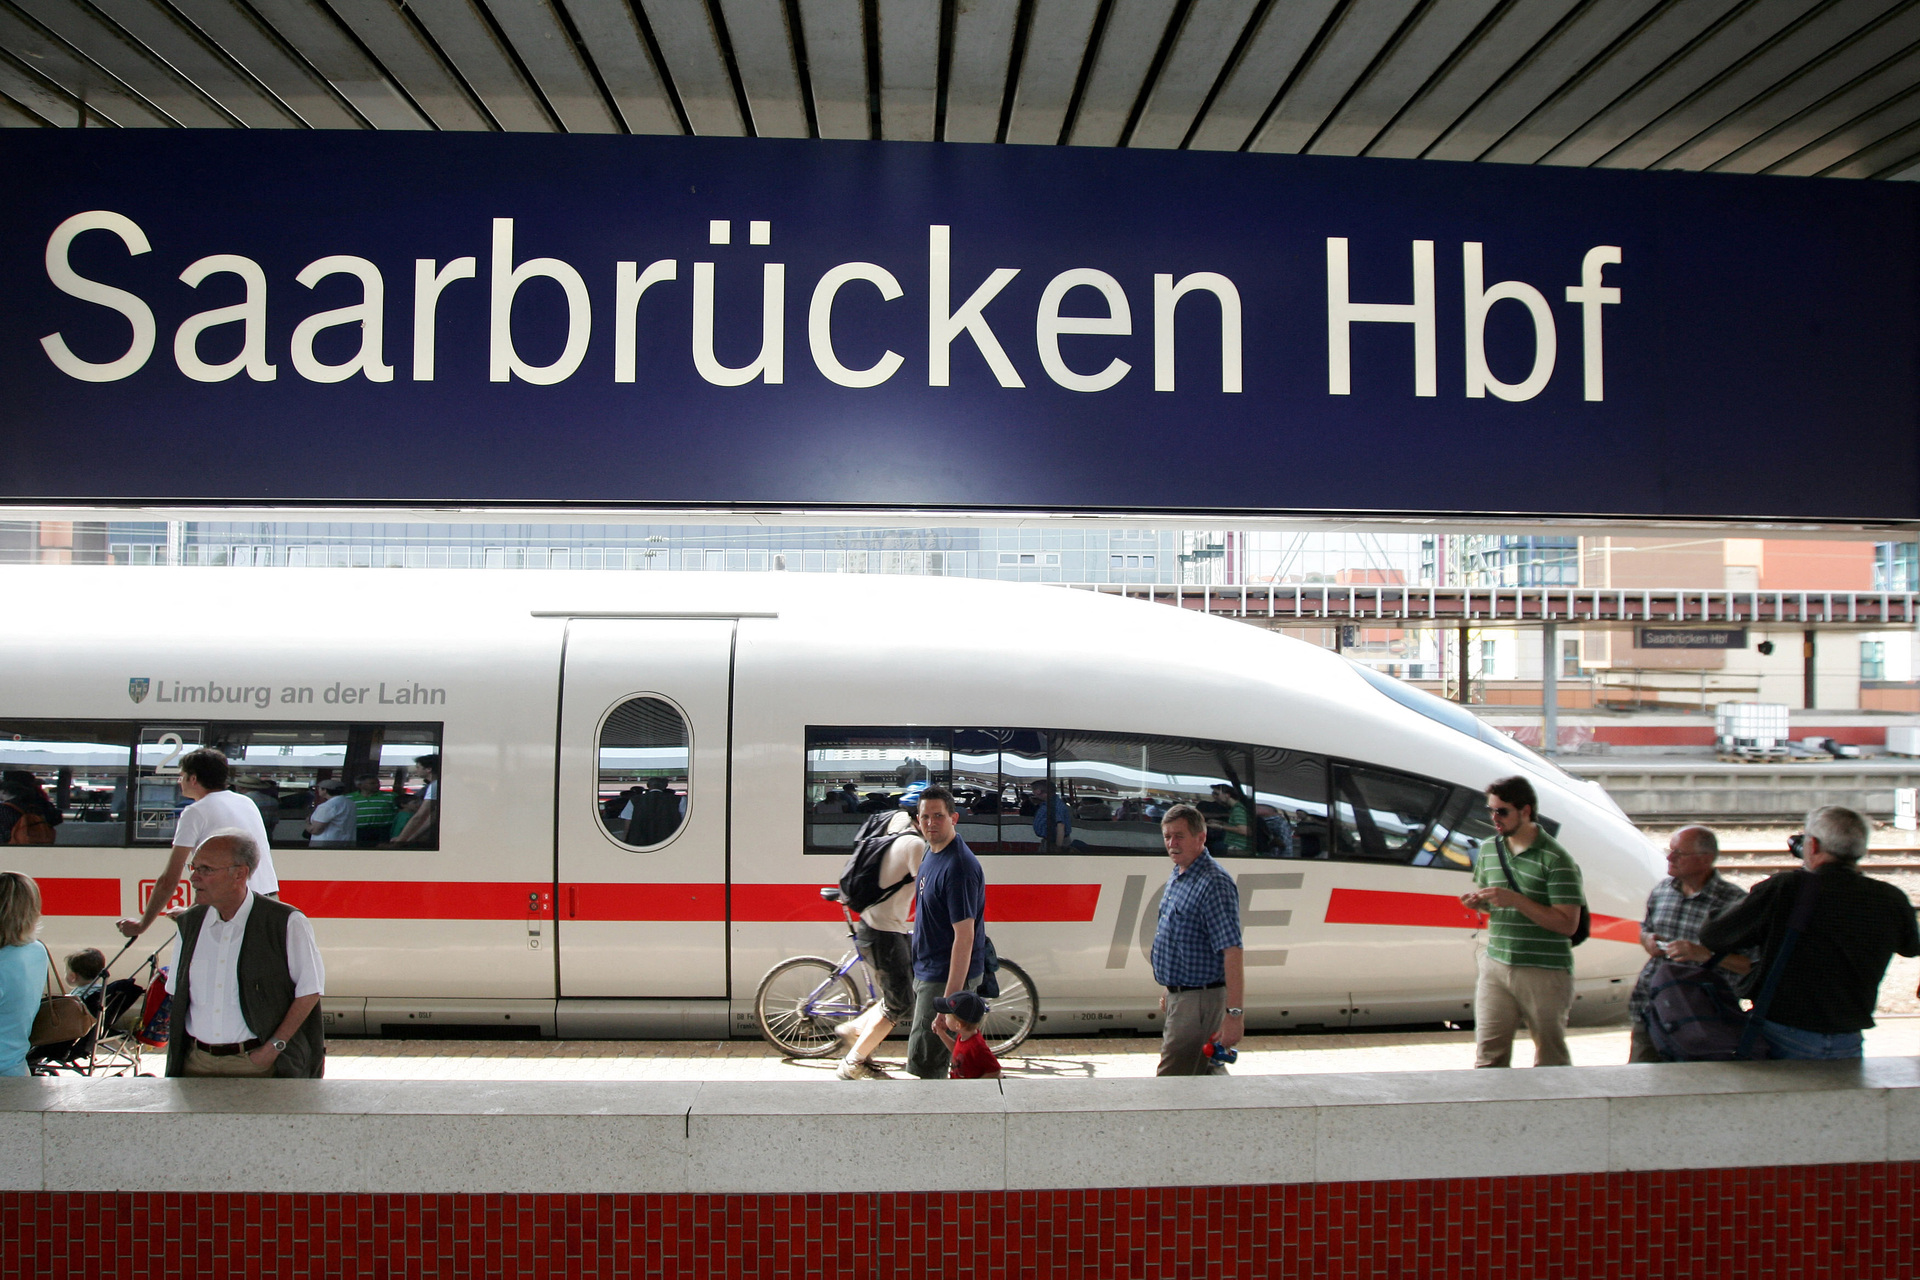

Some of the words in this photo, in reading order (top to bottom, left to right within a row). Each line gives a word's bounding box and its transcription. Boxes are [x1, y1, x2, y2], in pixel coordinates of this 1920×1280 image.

[40, 210, 1243, 393] Saarbrücken
[1326, 237, 1623, 402] Hbf
[1646, 633, 1709, 644] Saarbrücken
[1711, 633, 1729, 644] Hbf
[155, 680, 272, 709] Limburg
[280, 686, 314, 704] an
[322, 682, 370, 705] der
[378, 682, 447, 705] Lahn
[155, 732, 184, 775] 2
